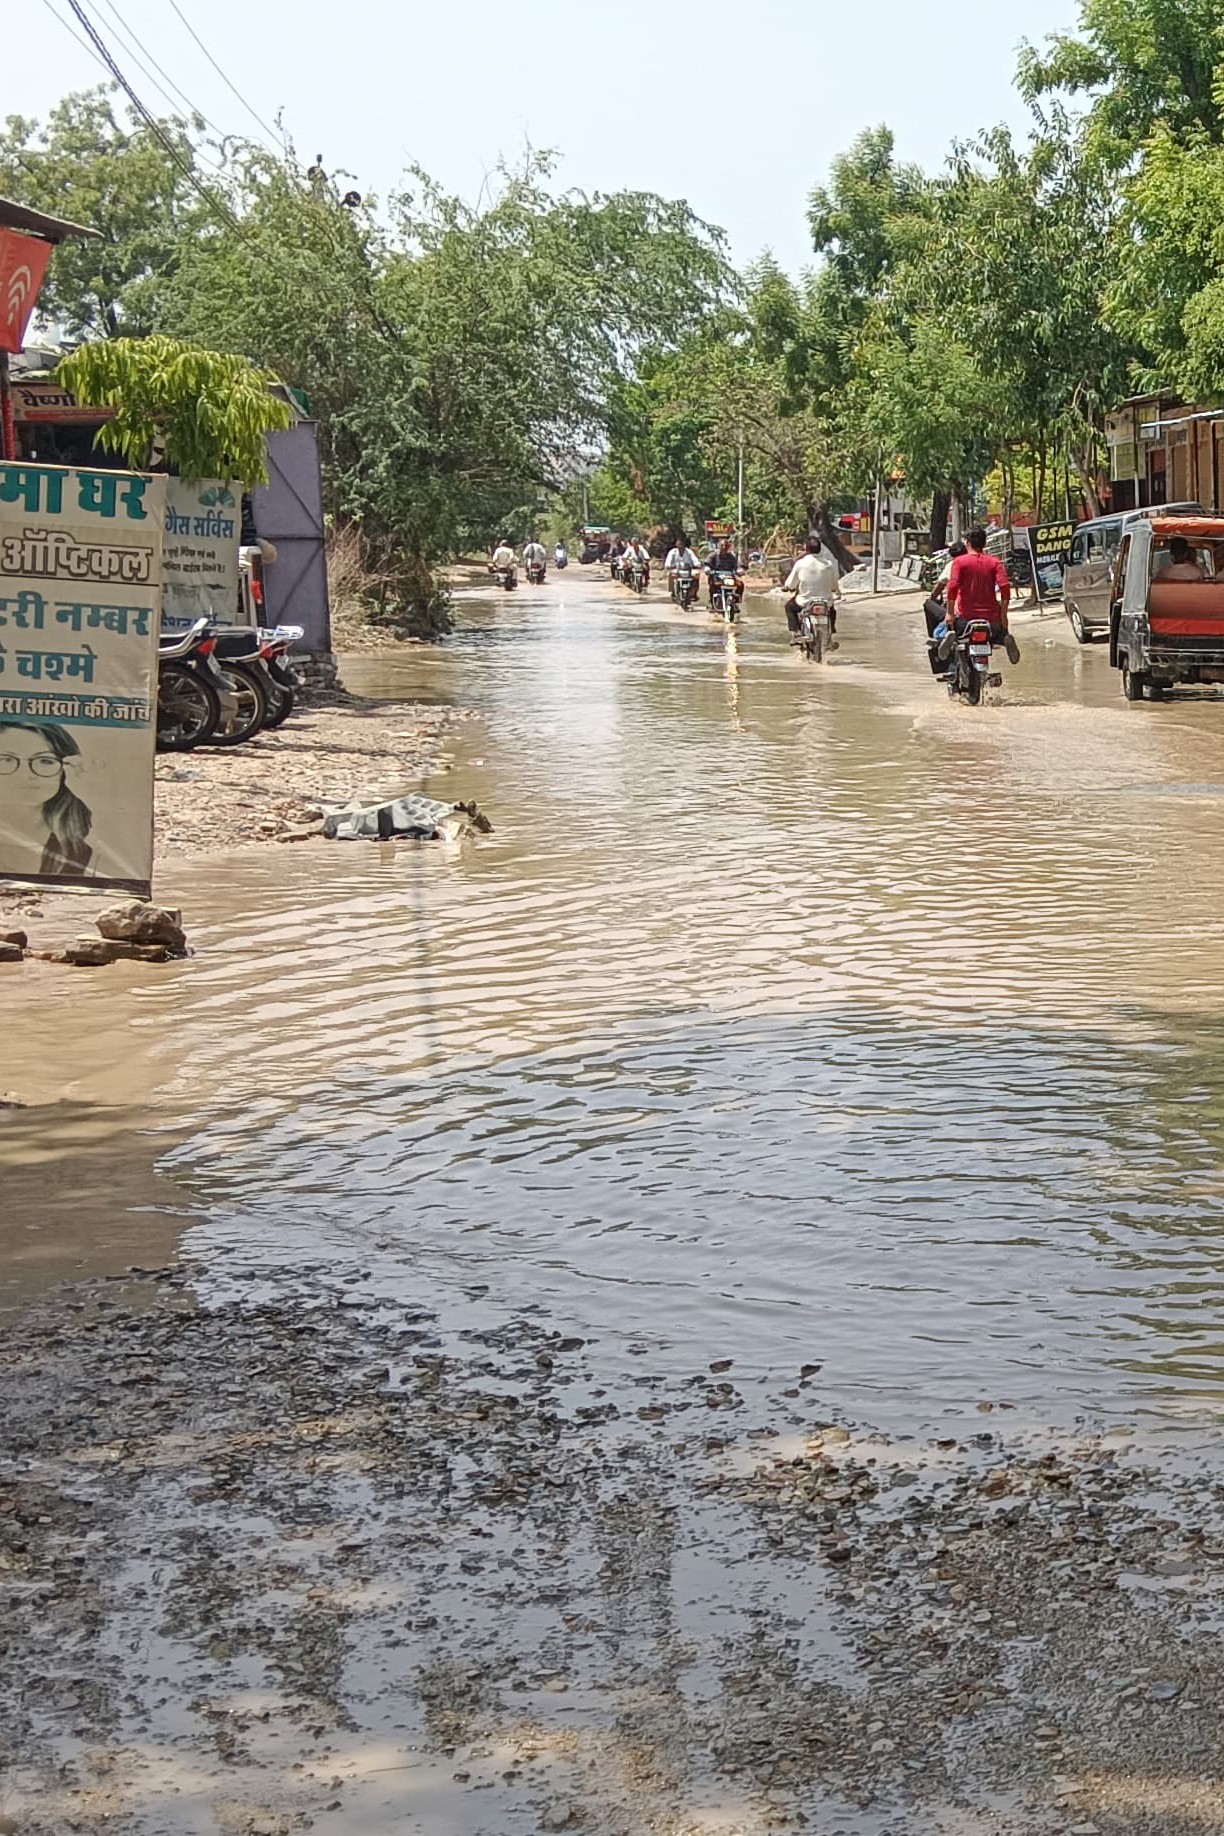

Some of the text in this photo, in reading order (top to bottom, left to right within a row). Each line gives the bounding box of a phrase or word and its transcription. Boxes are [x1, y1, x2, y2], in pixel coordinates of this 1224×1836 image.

[76, 472, 152, 520] घर
[193, 509, 235, 538] सर्विस
[1036, 524, 1073, 540] GSM
[2, 527, 153, 581] ऑप्टिकल
[54, 602, 152, 635] नम्बर
[15, 644, 98, 683] चश्मे
[84, 697, 109, 719] की
